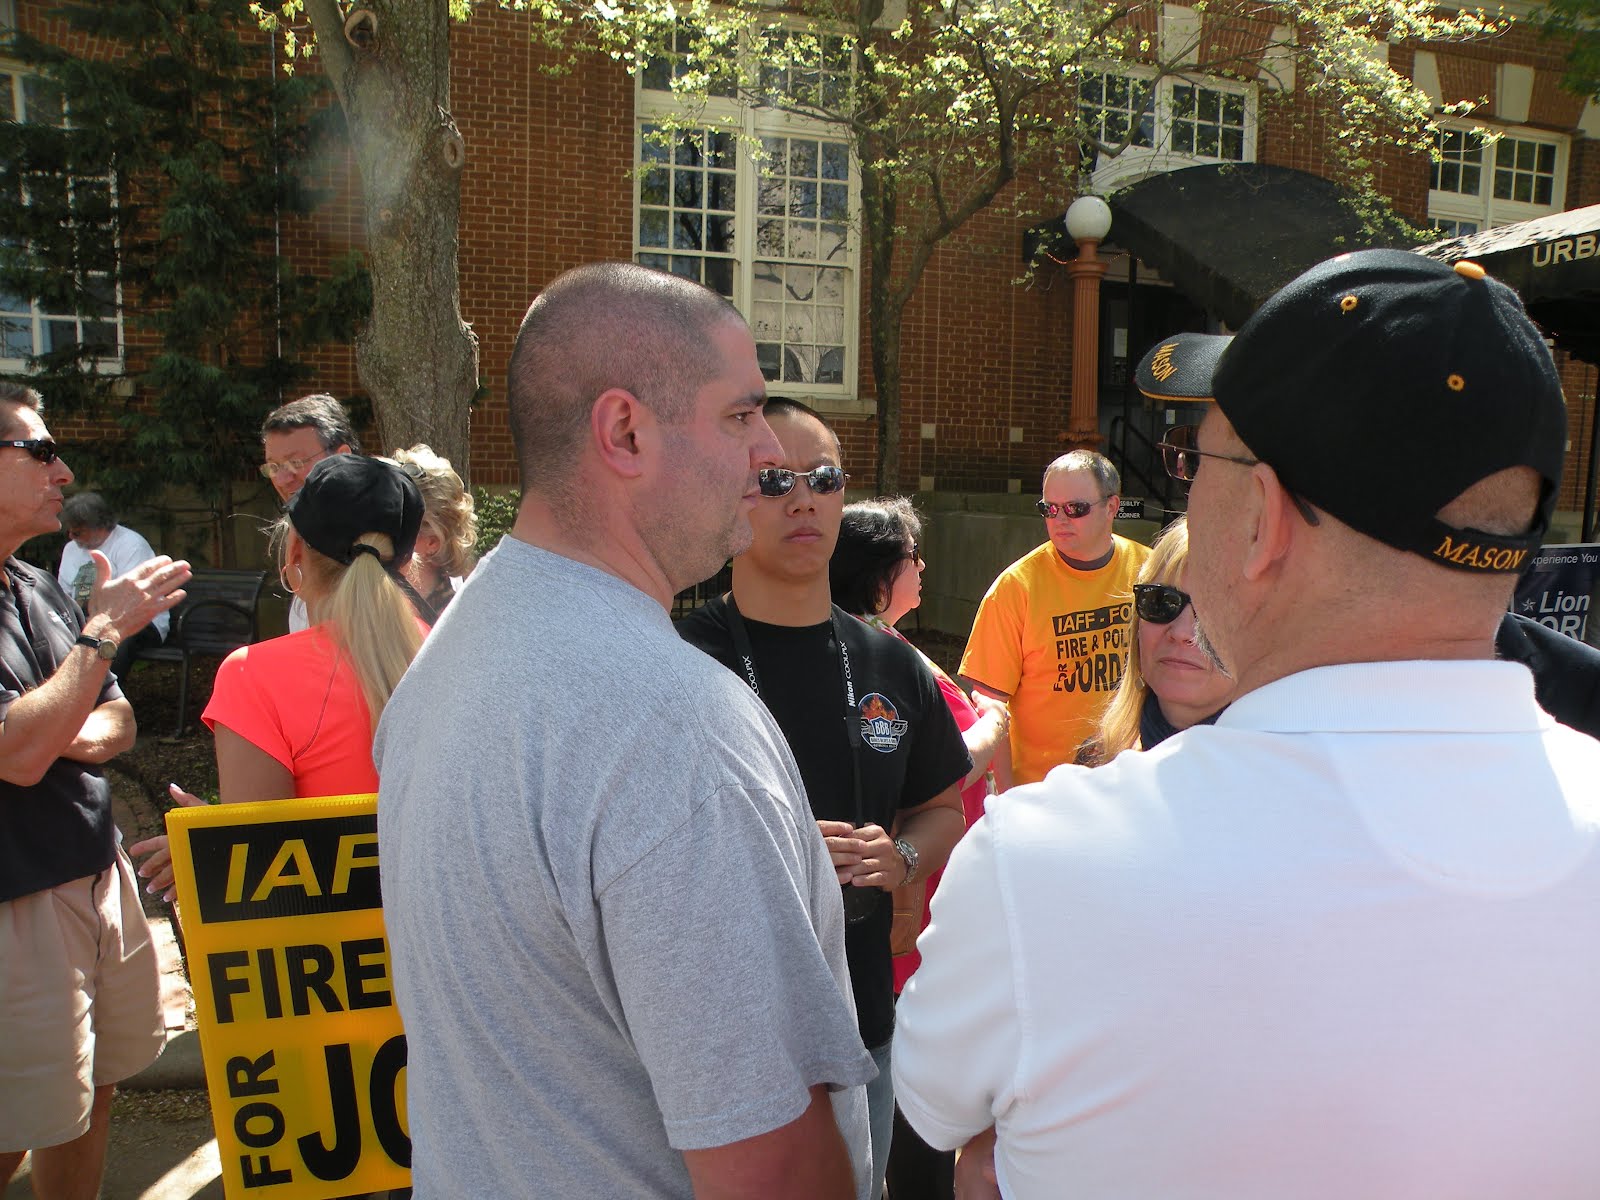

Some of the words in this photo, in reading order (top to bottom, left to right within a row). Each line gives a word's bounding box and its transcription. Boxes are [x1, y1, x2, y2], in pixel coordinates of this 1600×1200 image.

[1533, 234, 1600, 268] URB
[1151, 342, 1180, 382] MASON
[1433, 536, 1528, 569] MASON
[1581, 553, 1598, 563] You
[1539, 591, 1591, 613] Lion
[1057, 612, 1095, 634] IAFF
[839, 640, 851, 679] COOLPIX
[1056, 636, 1088, 659] FIRE
[1092, 635, 1099, 652] &
[1053, 663, 1068, 691] FOR
[1064, 652, 1128, 693] JORD
[847, 681, 856, 706] Nikon
[875, 720, 890, 735] BBB
[225, 832, 379, 904] IAF
[207, 937, 392, 1024] FIRE
[226, 1049, 293, 1188] FOR
